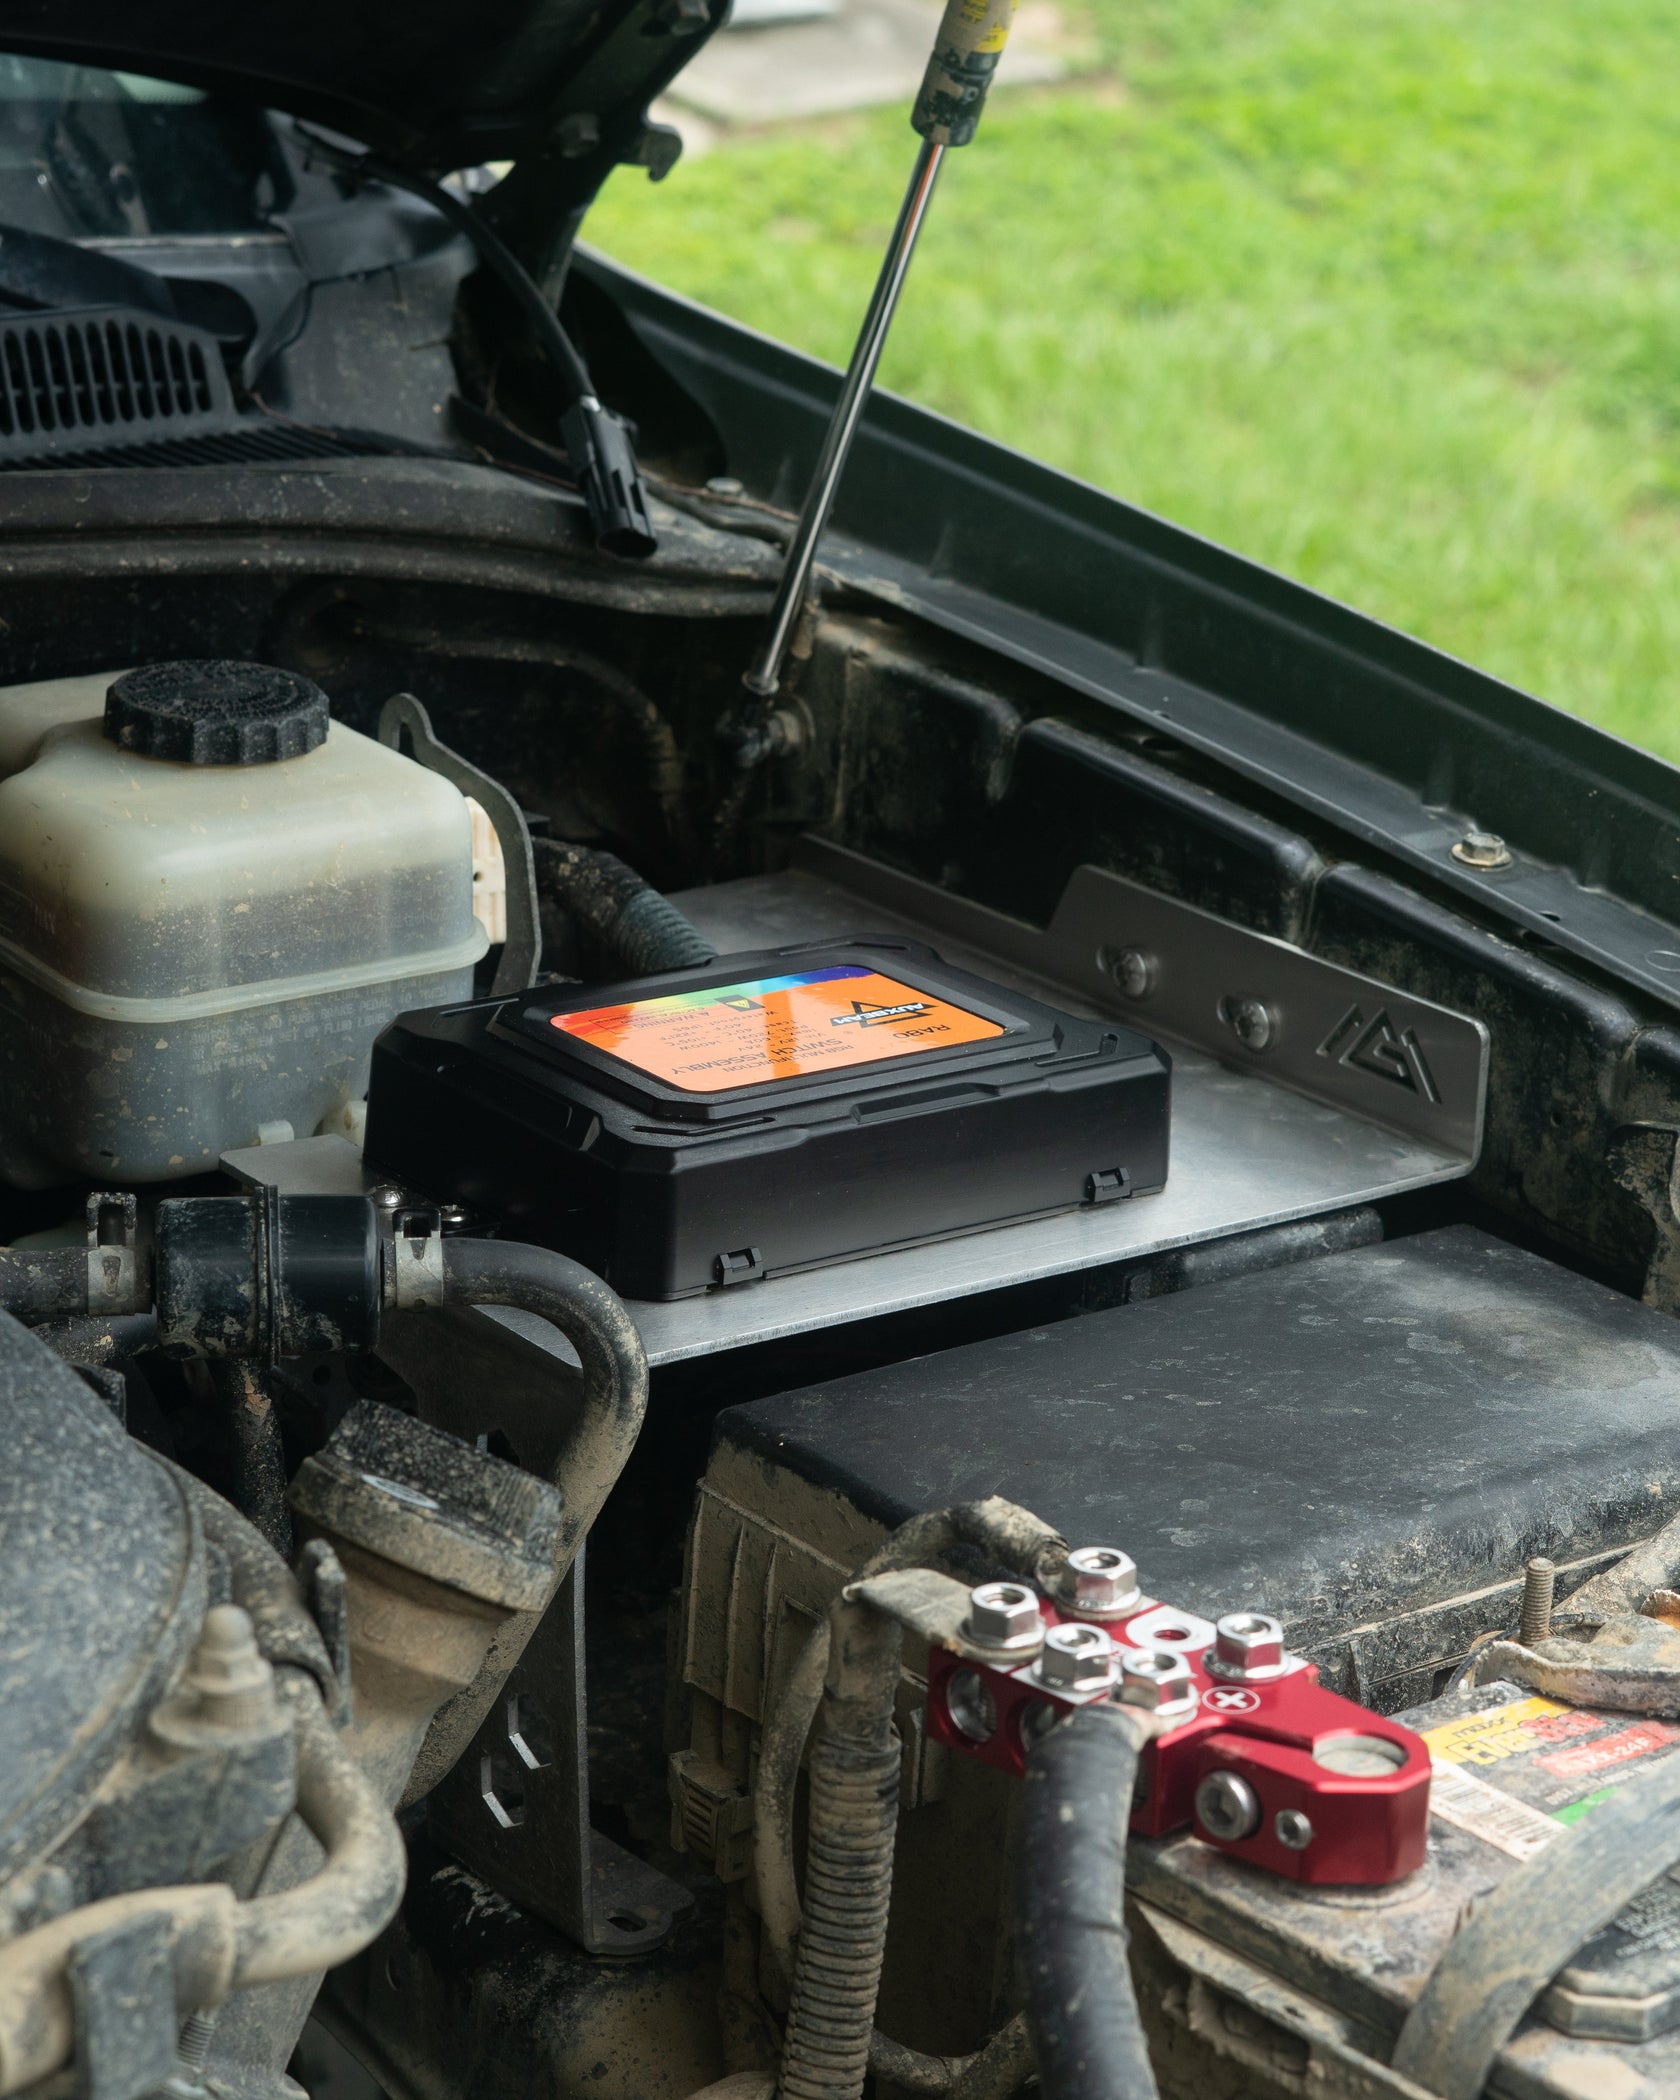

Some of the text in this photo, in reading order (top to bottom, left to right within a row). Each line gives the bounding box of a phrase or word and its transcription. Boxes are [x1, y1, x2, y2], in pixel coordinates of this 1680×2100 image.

[829, 1001, 927, 1025] AUXBEAM
[670, 1037, 845, 1076] SWITCH ASSEMBLY
